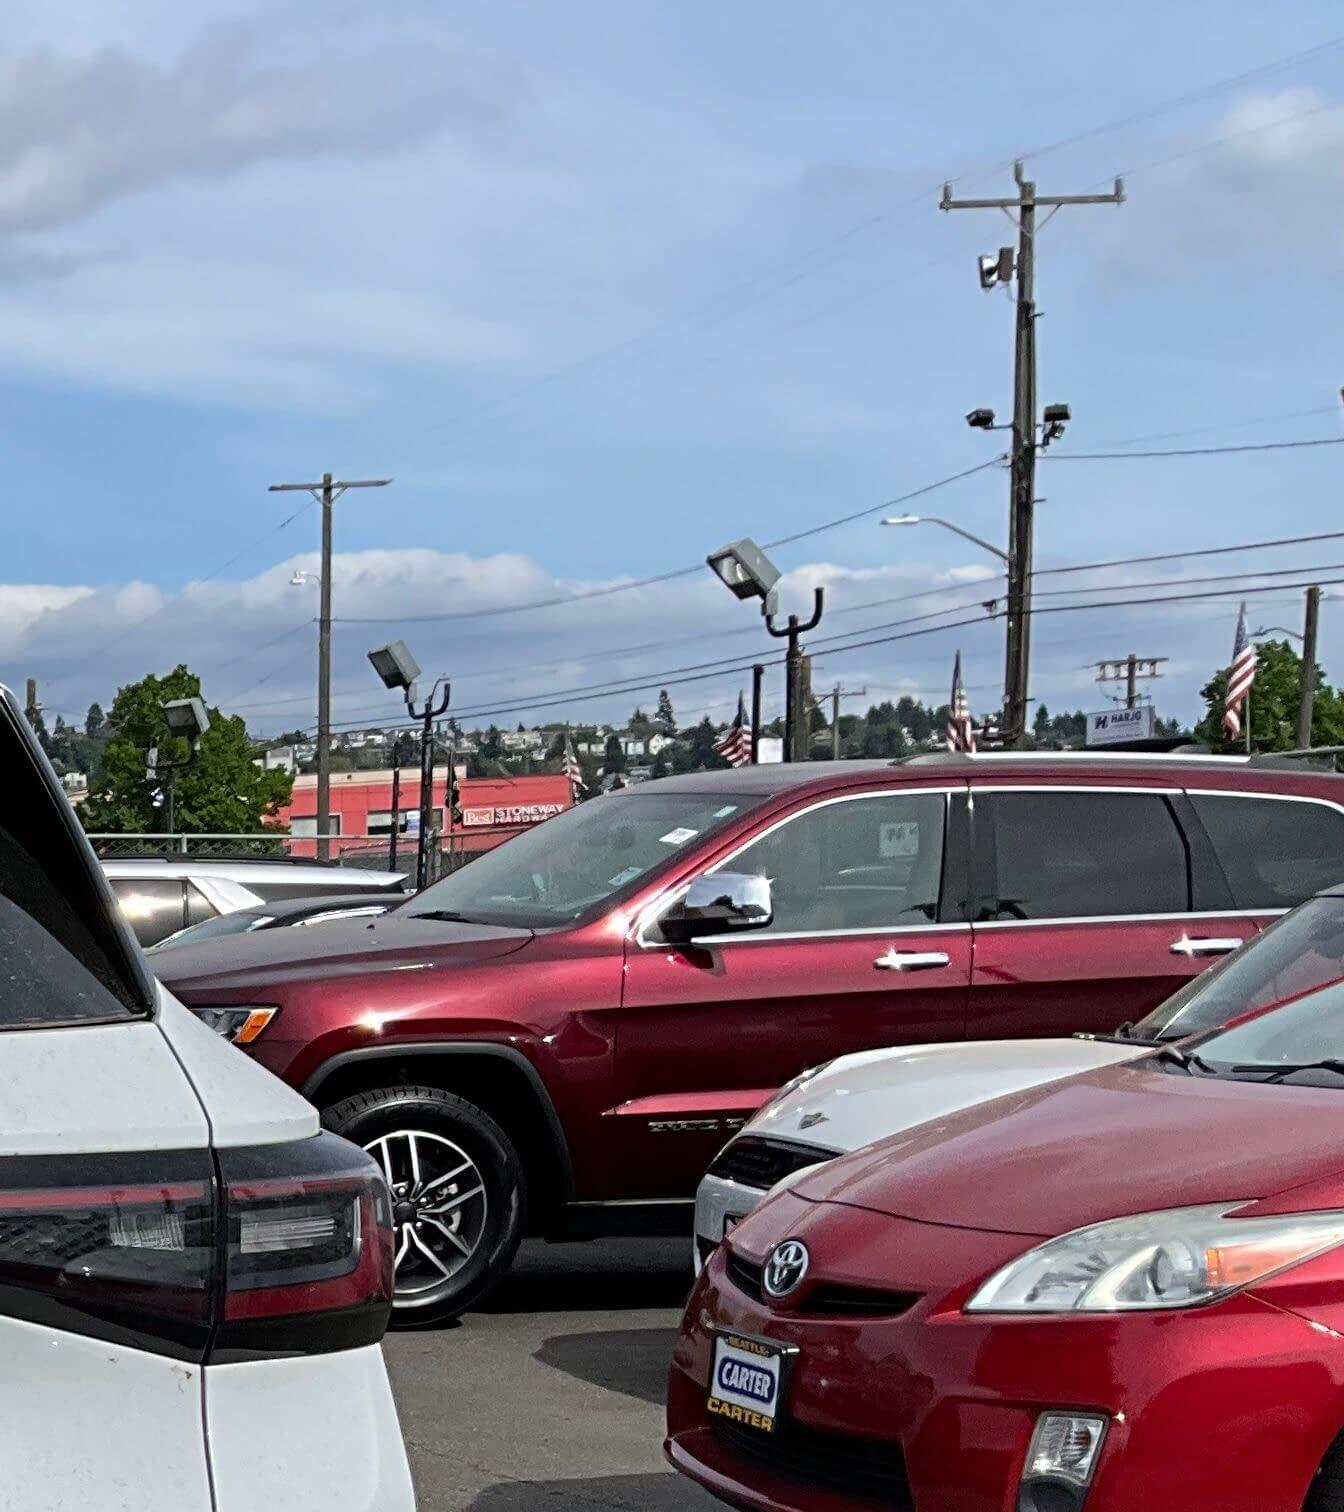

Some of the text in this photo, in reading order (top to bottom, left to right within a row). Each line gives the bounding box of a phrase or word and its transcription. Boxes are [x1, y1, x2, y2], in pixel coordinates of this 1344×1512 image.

[1111, 710, 1142, 723] HARJO
[495, 804, 564, 818] STONEWAY
[495, 813, 555, 823] HARDWA
[722, 1361, 771, 1398] CARTER
[707, 1397, 773, 1432] CARTER
